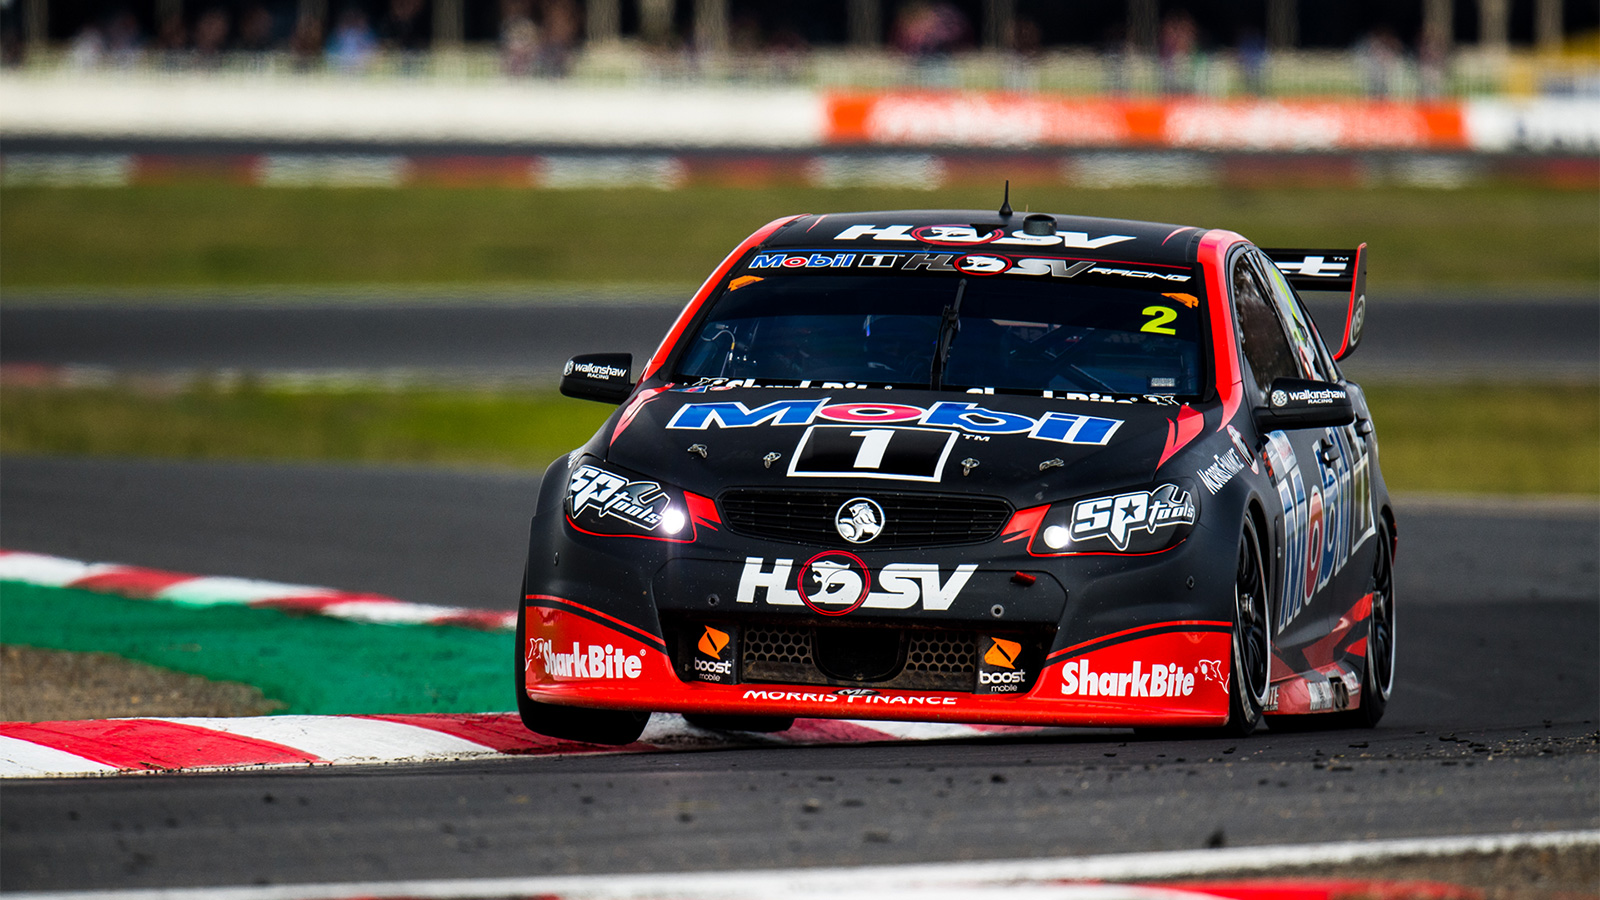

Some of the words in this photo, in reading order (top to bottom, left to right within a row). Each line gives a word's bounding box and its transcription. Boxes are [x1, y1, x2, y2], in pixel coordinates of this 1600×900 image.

[748, 254, 855, 269] Mobil
[1087, 266, 1192, 282] RACING
[1140, 306, 1178, 336] 2
[575, 361, 627, 378] walkinshaw
[587, 372, 610, 381] RACING
[1289, 388, 1346, 400] walkinshaw
[665, 397, 1125, 446] Mobil
[852, 428, 896, 469] 1
[963, 433, 991, 443] TM
[570, 466, 628, 512] SP
[603, 491, 664, 525] tools
[1073, 493, 1149, 544] SP
[1149, 501, 1195, 526] tools
[694, 657, 732, 675] boost
[979, 668, 1026, 684] boost
[699, 673, 721, 682] mobile
[990, 683, 1018, 692] mobile
[743, 690, 838, 703] MORRIS
[853, 693, 958, 706] FINANCE
